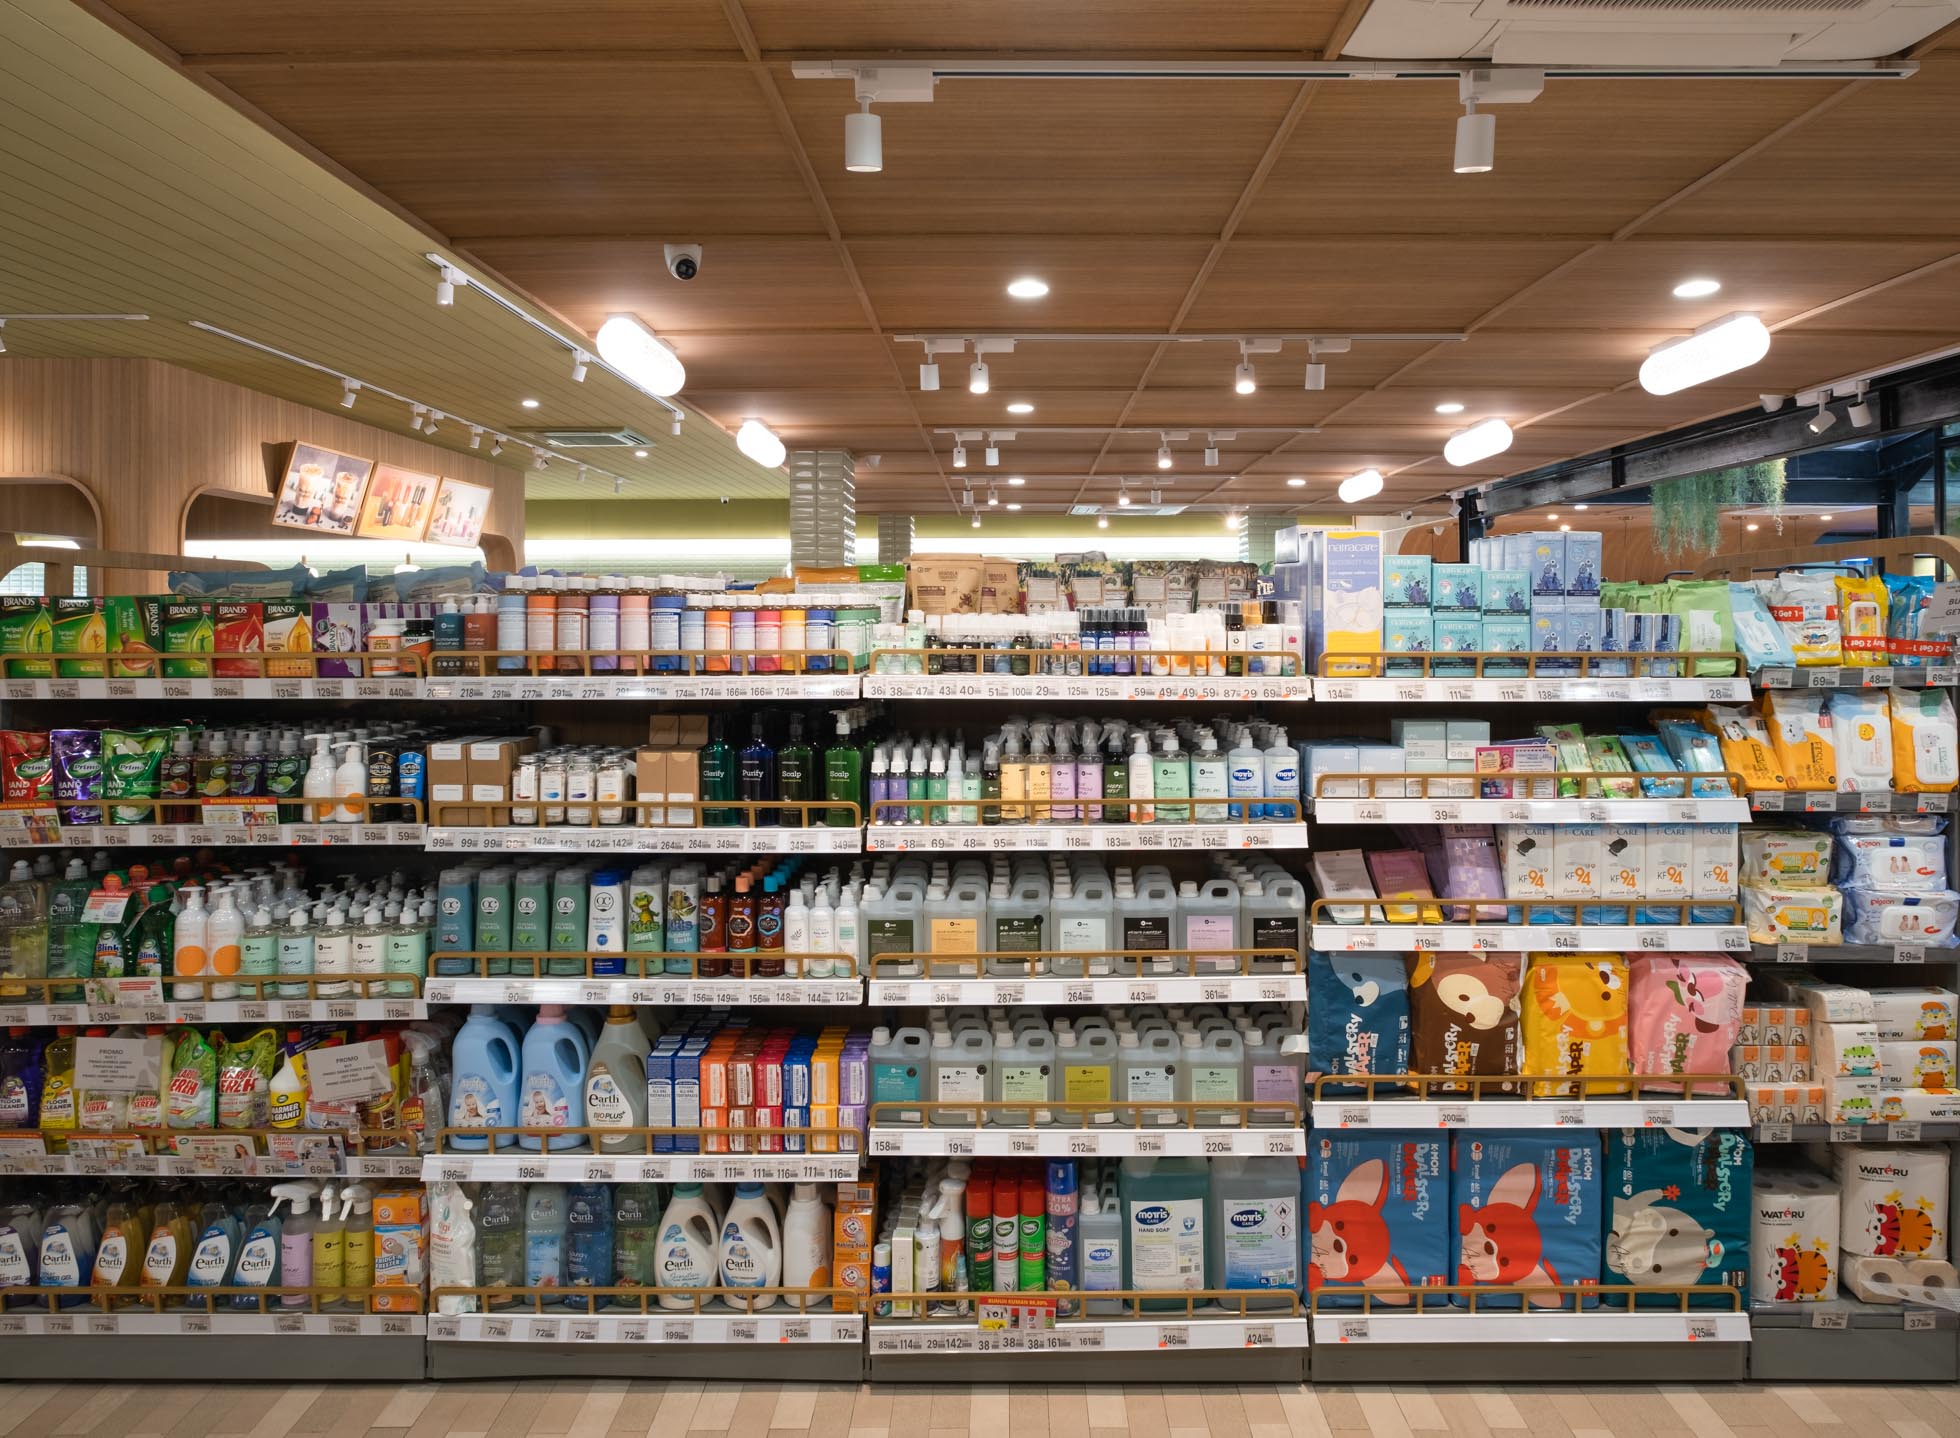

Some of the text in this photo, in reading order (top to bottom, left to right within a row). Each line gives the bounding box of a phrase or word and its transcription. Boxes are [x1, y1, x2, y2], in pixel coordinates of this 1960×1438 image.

[1328, 544, 1378, 552] natracare
[704, 770, 724, 778] Clarify
[742, 770, 764, 778] Purify
[782, 770, 802, 778] Scalp
[830, 770, 850, 778] Scalp
[1518, 869, 1544, 888] KF94
[1564, 866, 1591, 886] KF94
[1610, 870, 1637, 888] KF94
[1657, 866, 1684, 885] KF94
[1704, 866, 1730, 884] KF94
[50, 904, 74, 916] earth
[630, 921, 660, 932] Kids
[97, 944, 119, 952] Blink
[138, 951, 160, 960] Blink
[589, 1094, 619, 1107] earth
[1048, 1204, 1071, 1212] 20%
[482, 1215, 510, 1226] earth
[531, 1210, 558, 1220] earth
[569, 1212, 594, 1224] earth
[618, 1210, 642, 1222] earth
[0, 1255, 21, 1263] arth
[42, 1254, 70, 1266] earth
[98, 1258, 122, 1268] earth
[147, 1258, 172, 1268] earth
[196, 1258, 224, 1270] earth
[242, 1258, 270, 1271] earth
[665, 1258, 692, 1271] earth
[726, 1258, 754, 1272] earth
